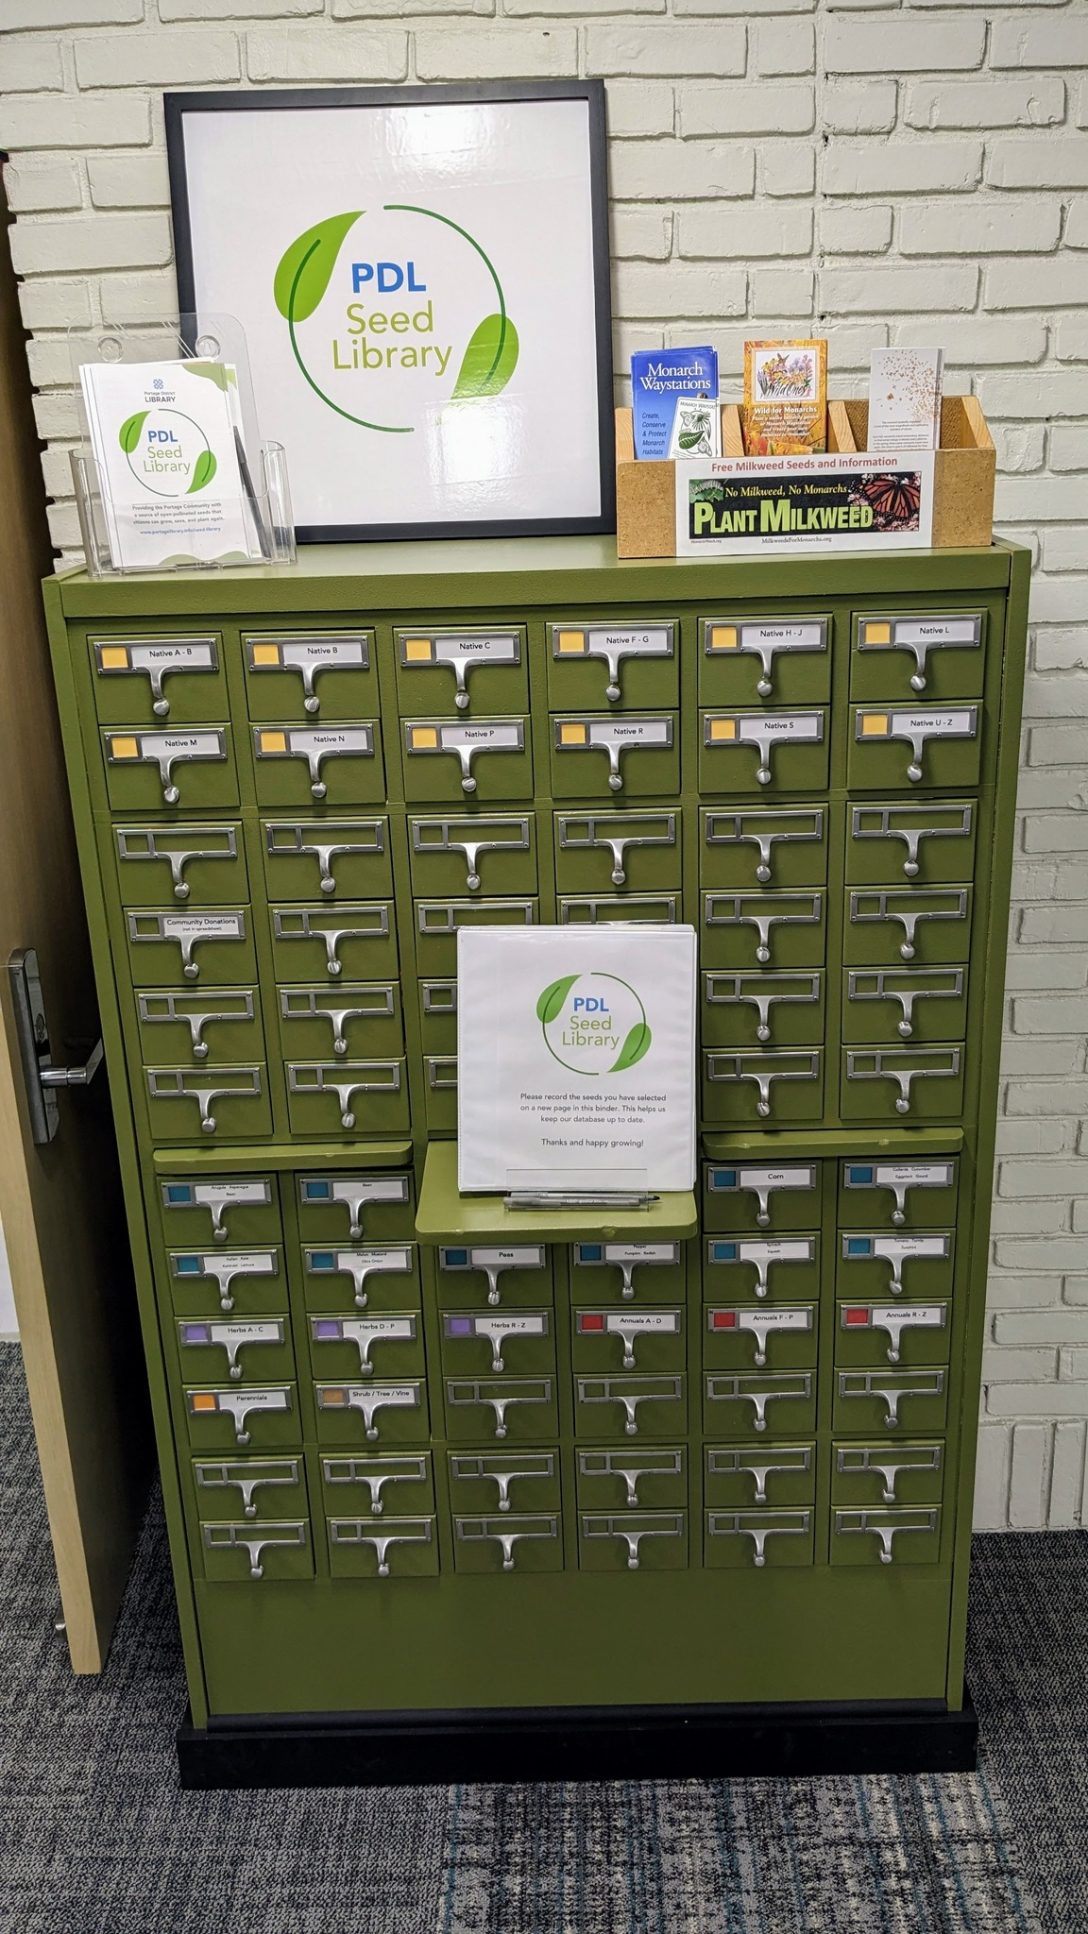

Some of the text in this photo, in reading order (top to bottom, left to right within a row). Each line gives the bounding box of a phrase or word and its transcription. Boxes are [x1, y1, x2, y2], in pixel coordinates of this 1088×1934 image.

[351, 261, 427, 294] PDL
[346, 300, 434, 335] Seed
[332, 337, 453, 377] Library
[648, 361, 703, 376] Monarch
[640, 376, 711, 394] Waystations
[148, 430, 178, 443] PDL
[147, 445, 182, 458] Seed
[143, 460, 190, 475] Library
[711, 457, 898, 472] Free Milkweed Seeds and Information
[724, 487, 738, 498] No
[741, 484, 786, 497] Milkweed,
[788, 484, 801, 494] No
[694, 499, 873, 535] PLANT MILKWEED
[149, 650, 172, 658] Native
[574, 998, 609, 1011] PDL
[570, 1015, 611, 1030] Seed
[563, 1031, 620, 1050] Library
[637, 1105, 656, 1113] helps
[585, 1139, 609, 1148] happy
[610, 1139, 644, 1148] growing!
